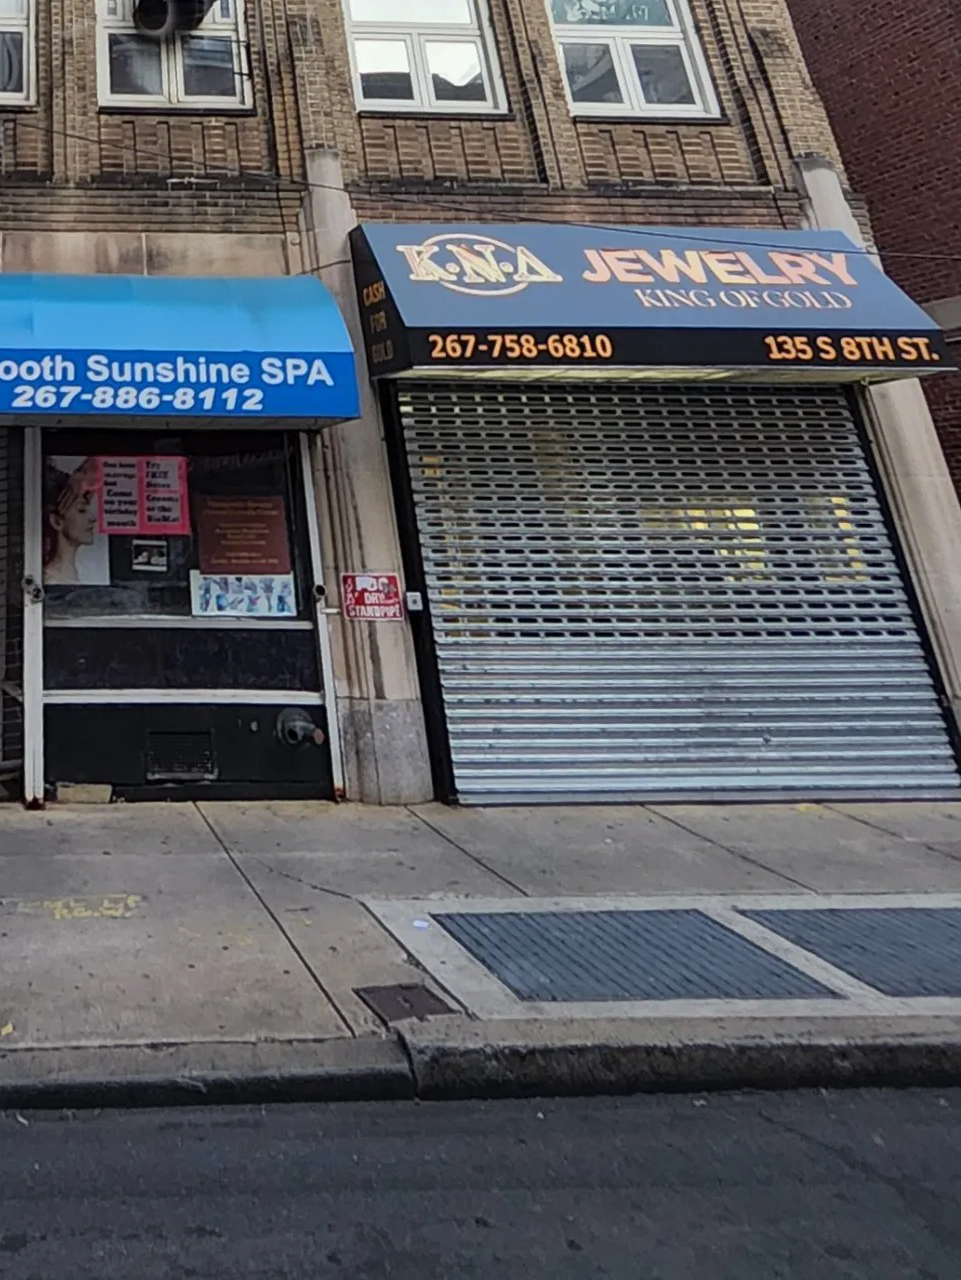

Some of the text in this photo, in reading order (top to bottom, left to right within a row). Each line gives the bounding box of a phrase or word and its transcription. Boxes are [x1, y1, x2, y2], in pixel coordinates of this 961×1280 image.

[582, 248, 858, 287] JEWELRY
[363, 280, 386, 307] CASH
[634, 288, 853, 310] KING OF GOLD
[428, 333, 940, 361] 267-758-6810 135 S 8TH ST.
[86, 356, 250, 384] Sunshine
[260, 358, 334, 387] SPA
[11, 385, 264, 411] 267-886-8112
[348, 604, 401, 617] STANDPIPE
